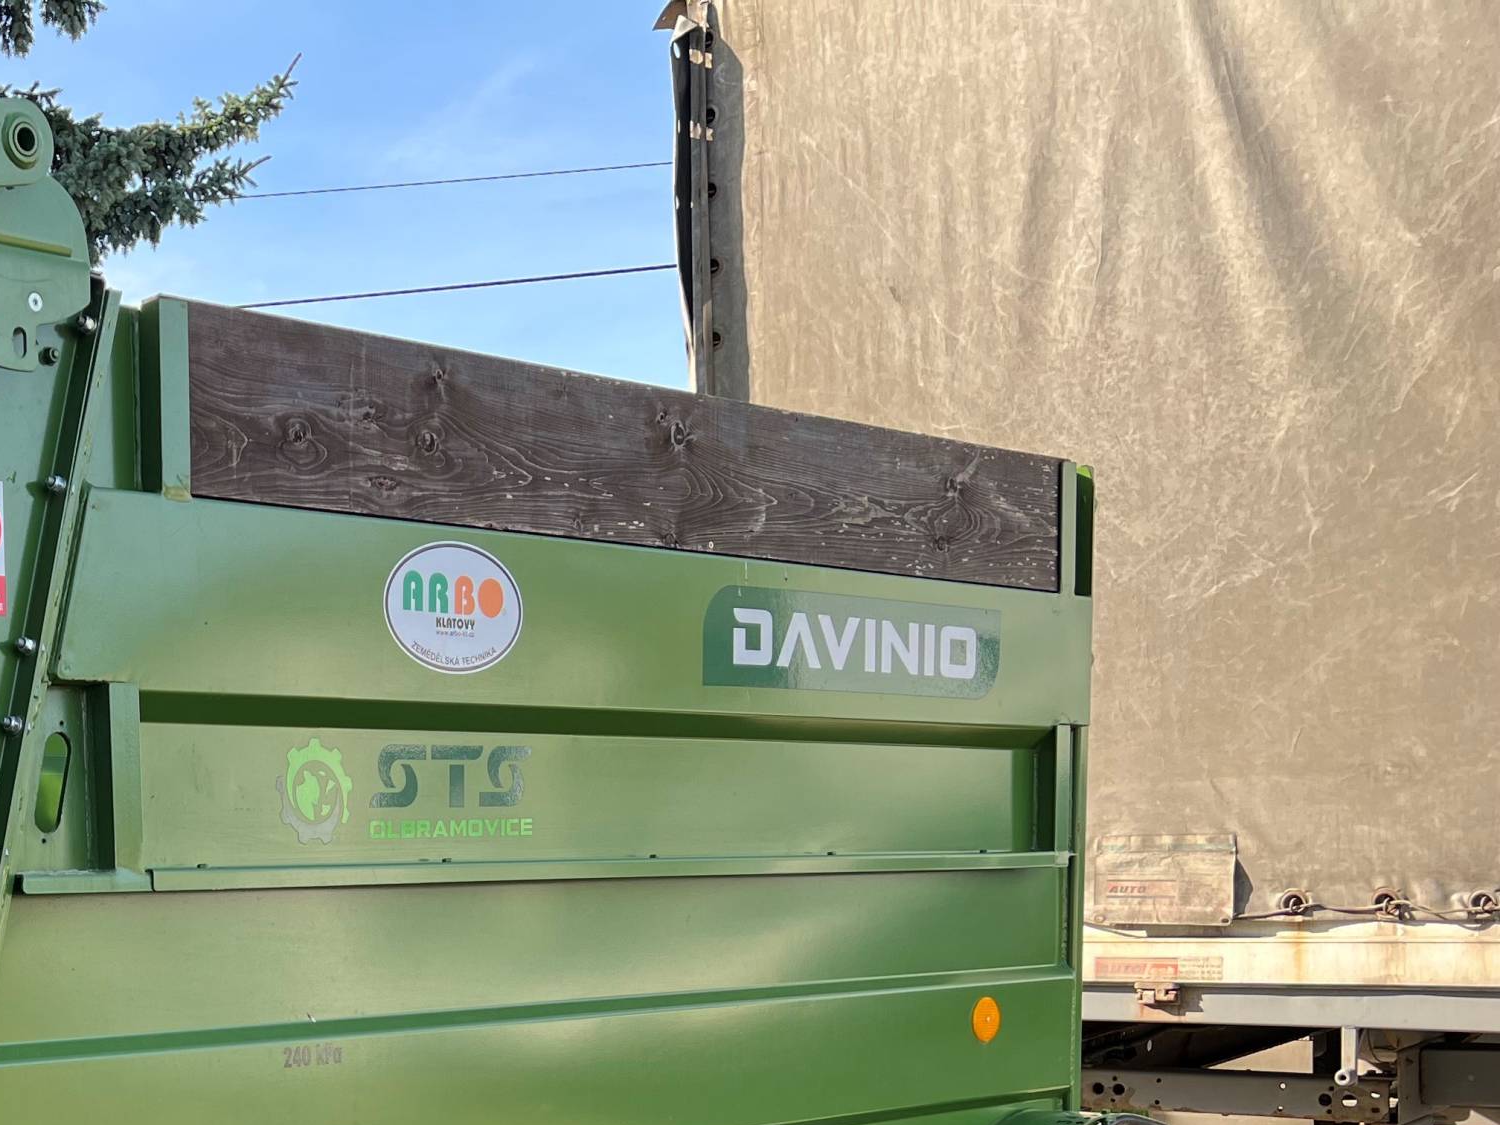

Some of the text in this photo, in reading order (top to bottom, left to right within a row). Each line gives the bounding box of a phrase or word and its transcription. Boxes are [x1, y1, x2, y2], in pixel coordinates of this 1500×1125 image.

[402, 569, 504, 619] ARBO
[435, 616, 475, 630] KLATOVY
[732, 607, 977, 680] DAVINIO
[462, 646, 497, 666] TECHNIKA
[368, 743, 533, 809] STS
[368, 817, 533, 839] OLBRAMOVICE
[1108, 885, 1147, 894] AUTO
[283, 1046, 311, 1069] 240
